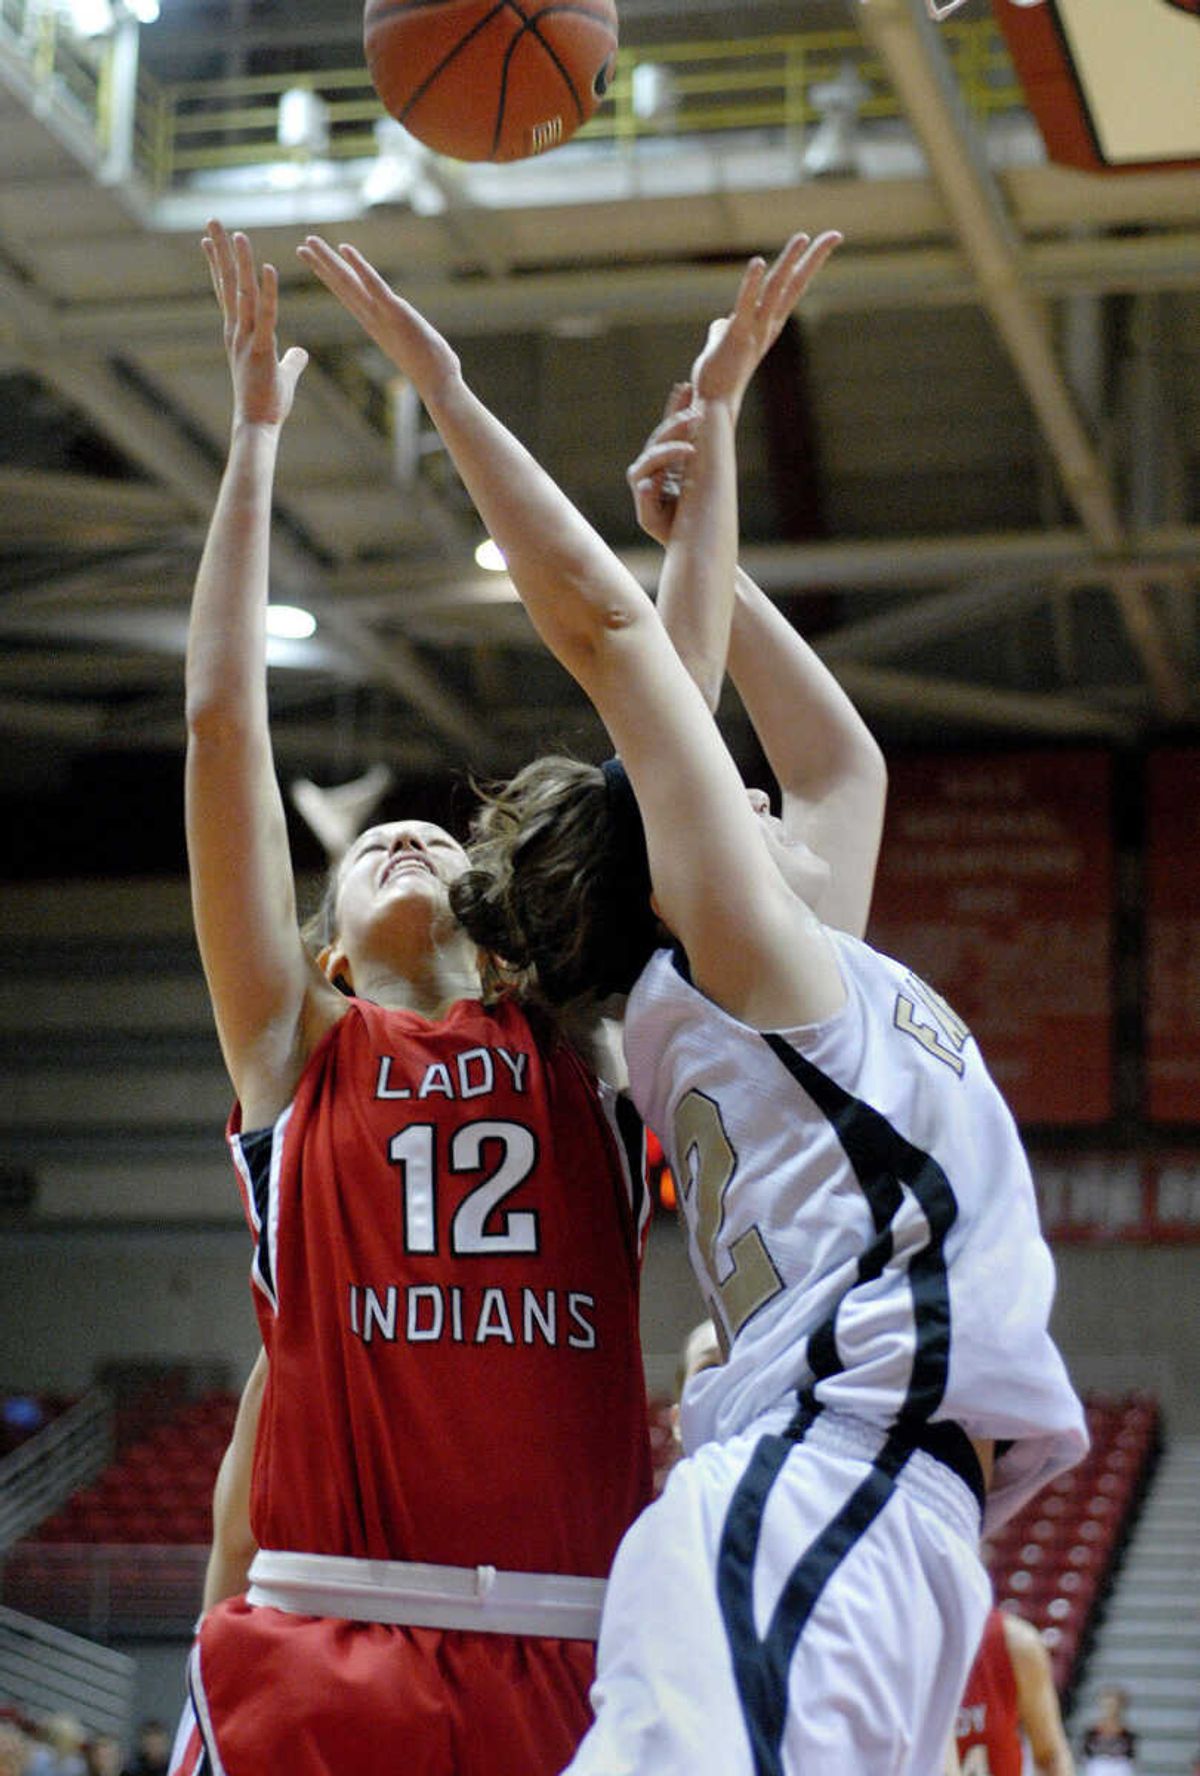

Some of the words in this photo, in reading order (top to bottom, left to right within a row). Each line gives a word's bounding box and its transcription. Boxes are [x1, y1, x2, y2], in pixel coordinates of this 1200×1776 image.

[375, 1046, 529, 1100] LADY
[387, 1116, 541, 1258] 12
[350, 1283, 597, 1349] INDIANS
